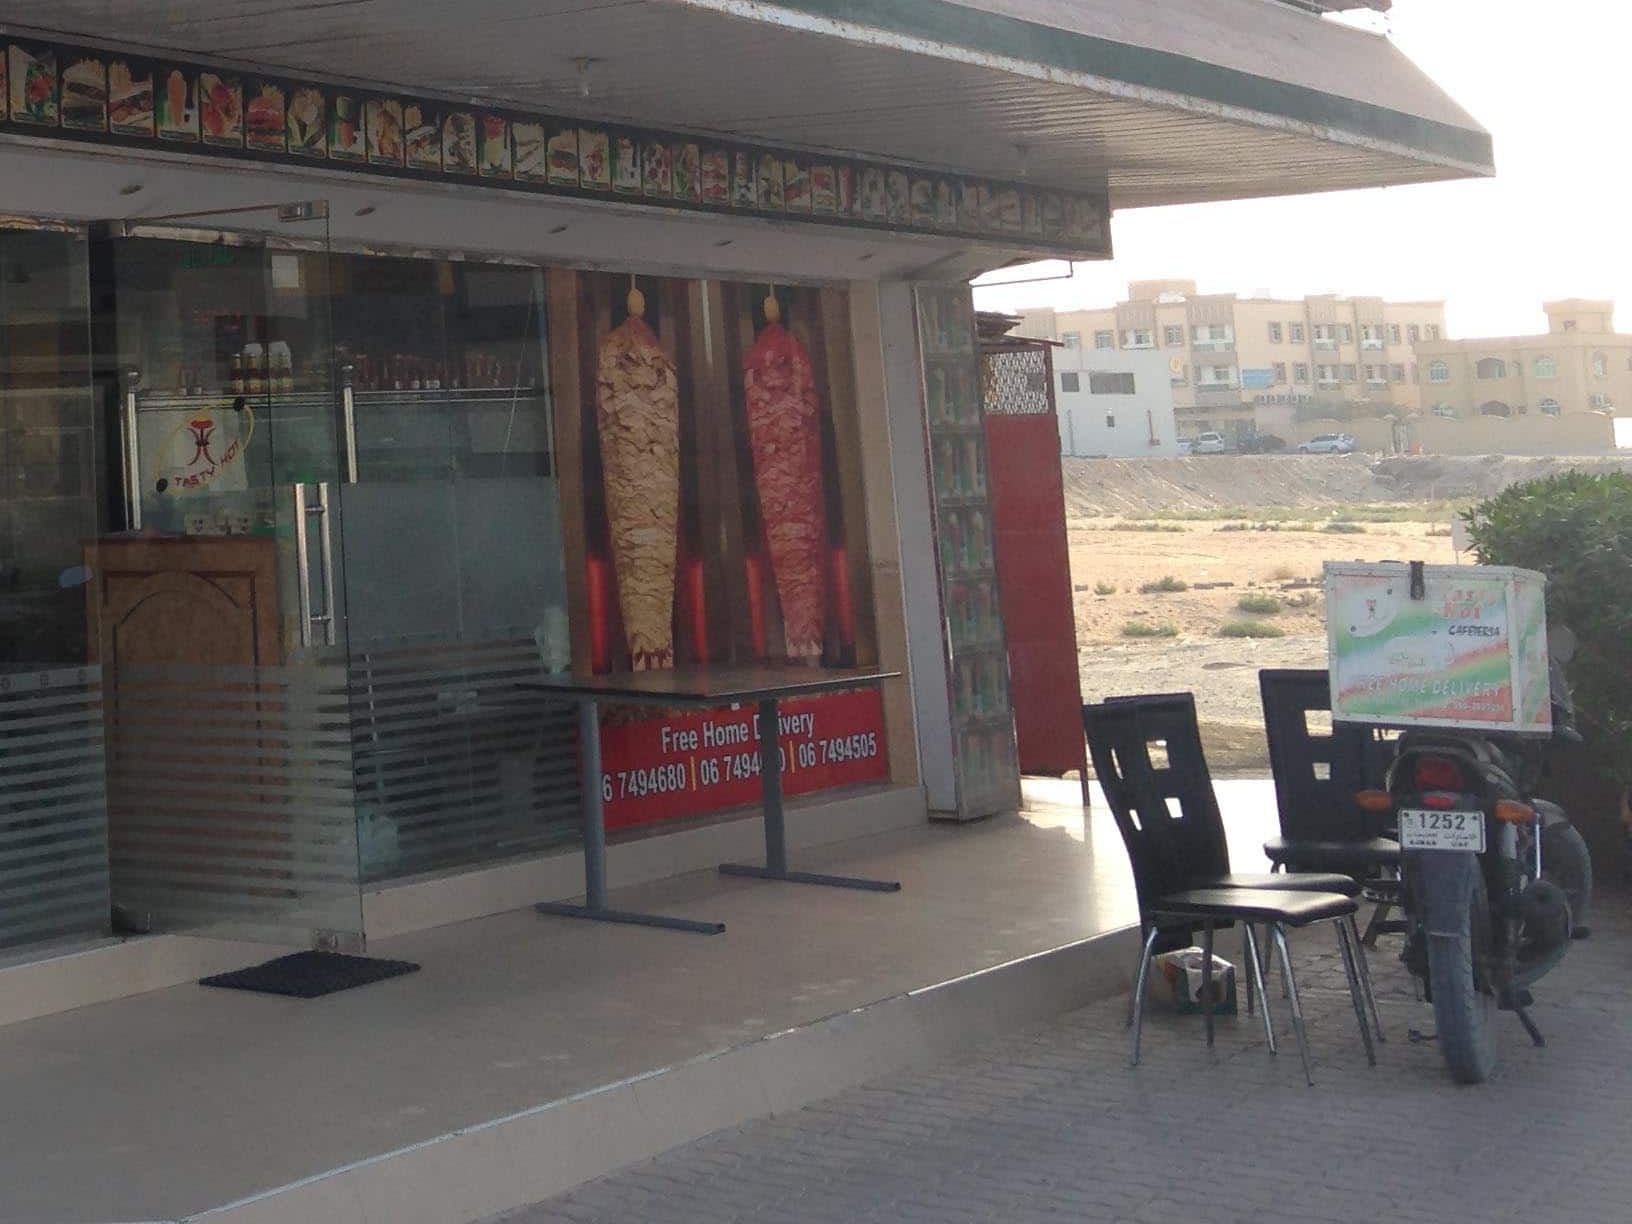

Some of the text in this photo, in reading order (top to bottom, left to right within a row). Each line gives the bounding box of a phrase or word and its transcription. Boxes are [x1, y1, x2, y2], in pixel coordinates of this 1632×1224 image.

[174, 465, 216, 488] TASTY
[661, 711, 815, 754] Free Home Divery
[602, 774, 613, 802] 6
[618, 762, 686, 800] 7494680
[700, 758, 719, 786] 06
[798, 742, 816, 768] 06
[819, 733, 877, 765] 7494505
[1419, 812, 1465, 830] 1252
